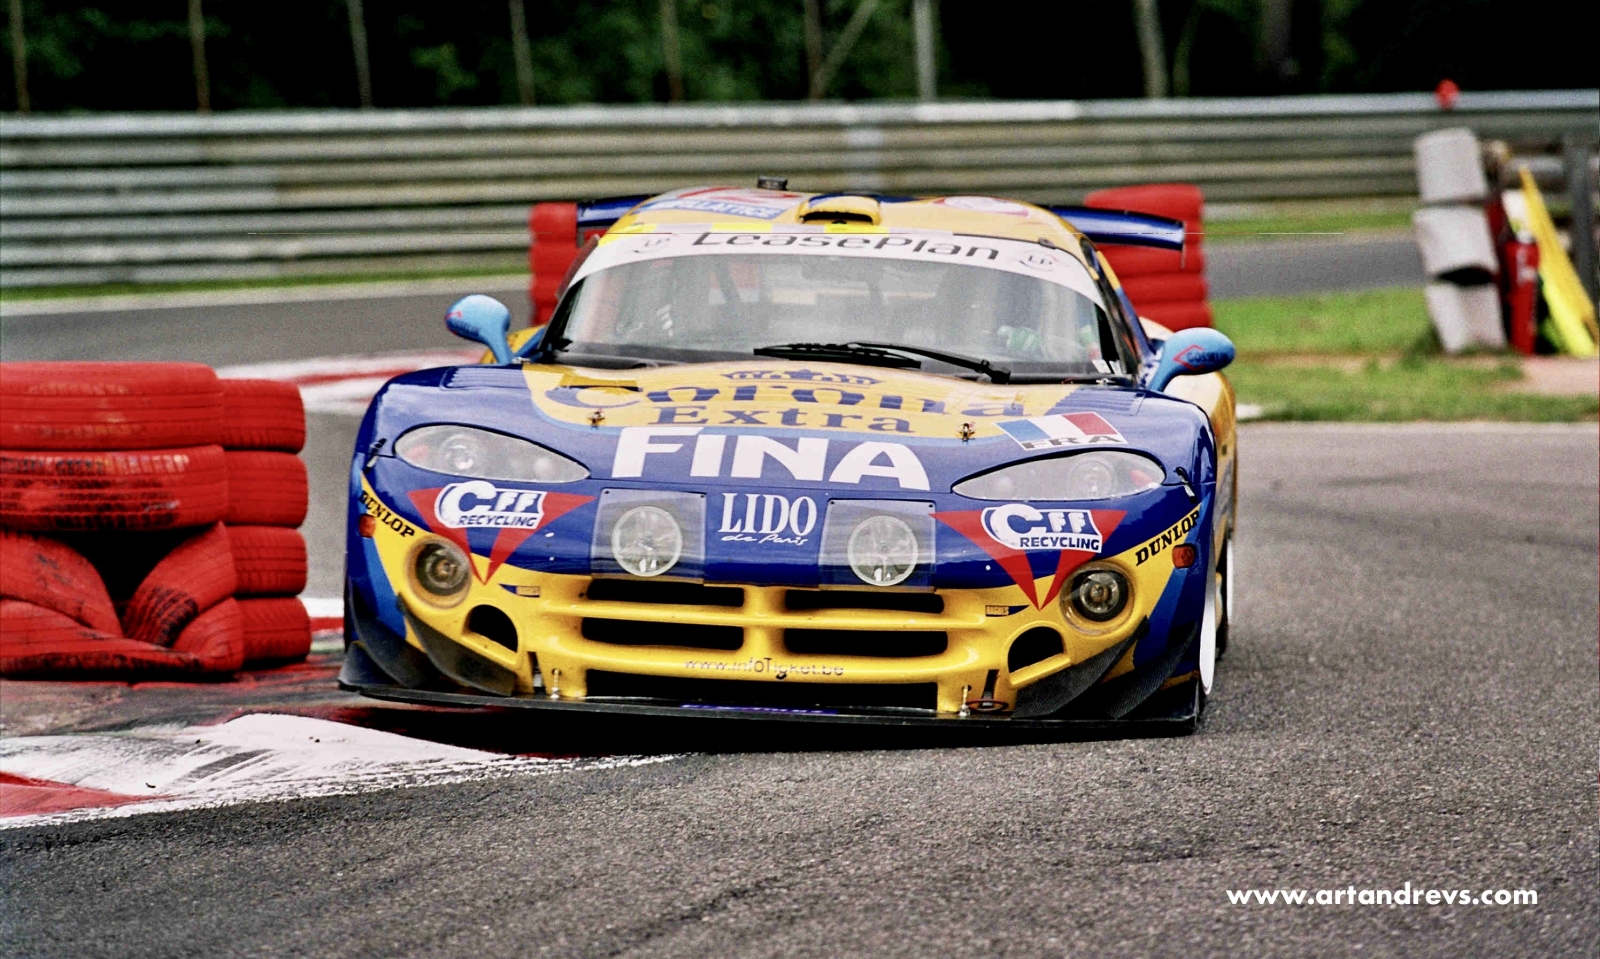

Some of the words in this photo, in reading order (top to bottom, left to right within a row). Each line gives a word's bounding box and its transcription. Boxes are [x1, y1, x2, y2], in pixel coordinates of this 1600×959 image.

[692, 231, 999, 260] LeasePlan
[545, 384, 1028, 418] Corona
[647, 405, 915, 434] Extra
[1021, 435, 1124, 449] FRA
[611, 426, 931, 491] FINA
[358, 490, 415, 537] DUNLOP
[458, 514, 538, 527] RECYCLING
[718, 493, 817, 536] LIDO
[721, 534, 757, 542] de
[758, 534, 808, 546] Paris
[1019, 536, 1100, 551] RECYCLING
[1135, 509, 1201, 566] DUNLOP
